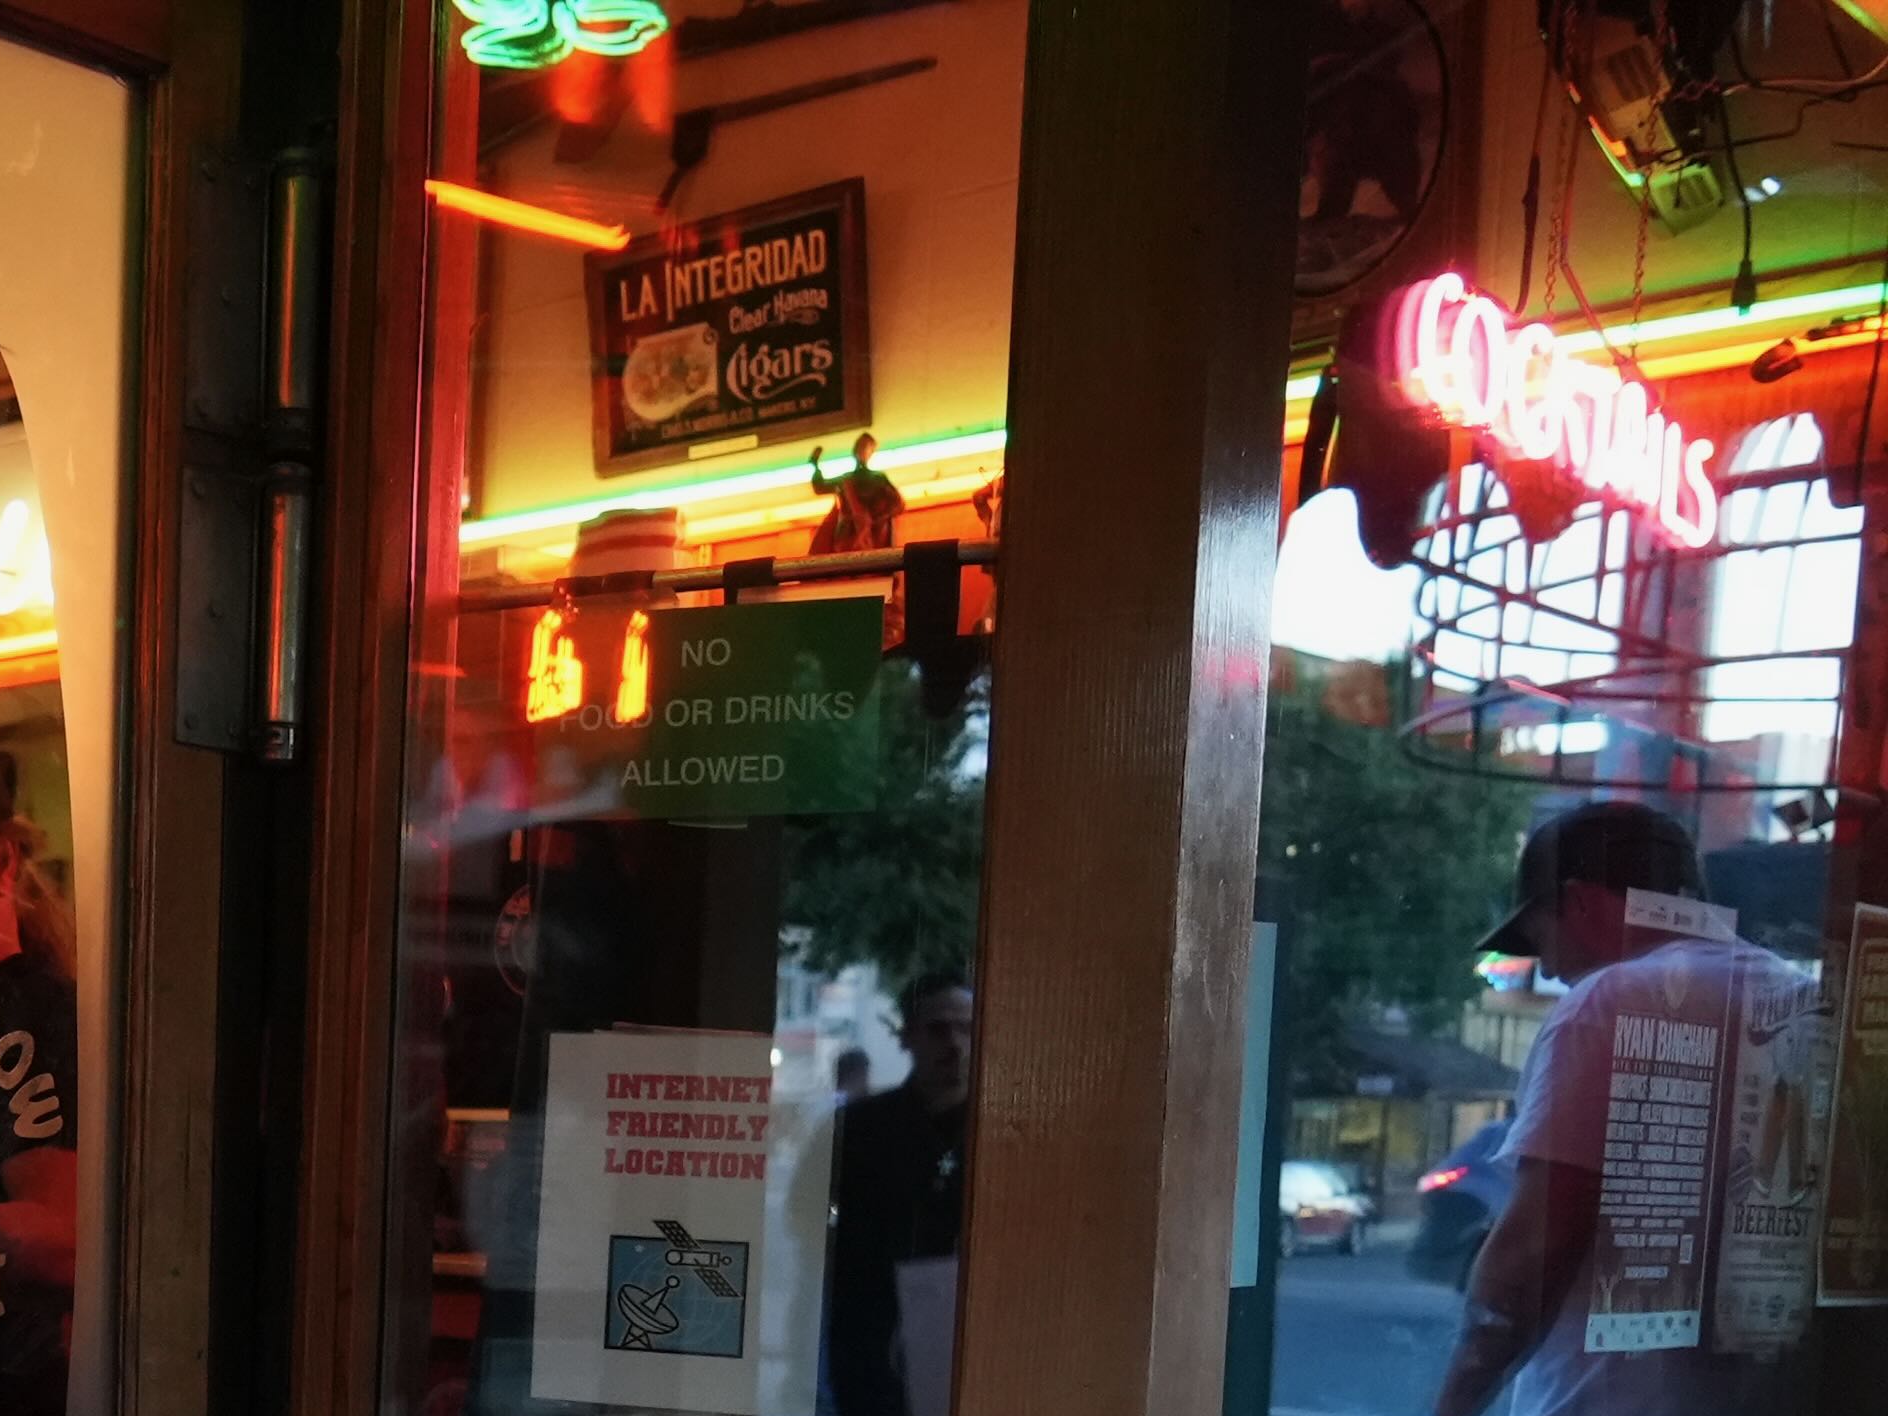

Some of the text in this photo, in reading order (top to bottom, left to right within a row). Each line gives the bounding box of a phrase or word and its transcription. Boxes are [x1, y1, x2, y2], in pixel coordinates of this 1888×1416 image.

[619, 229, 827, 322] LA INTEGRIDAD
[729, 302, 771, 334] Clear
[726, 339, 833, 403] Cigars
[681, 637, 732, 668] NO
[664, 698, 713, 728] OR
[724, 691, 856, 725] DRINKS
[620, 754, 786, 788] ALLOWED
[606, 1074, 772, 1104] INTERNET
[605, 1110, 771, 1143] FRIENDLY
[603, 1147, 767, 1181] LOCATION
